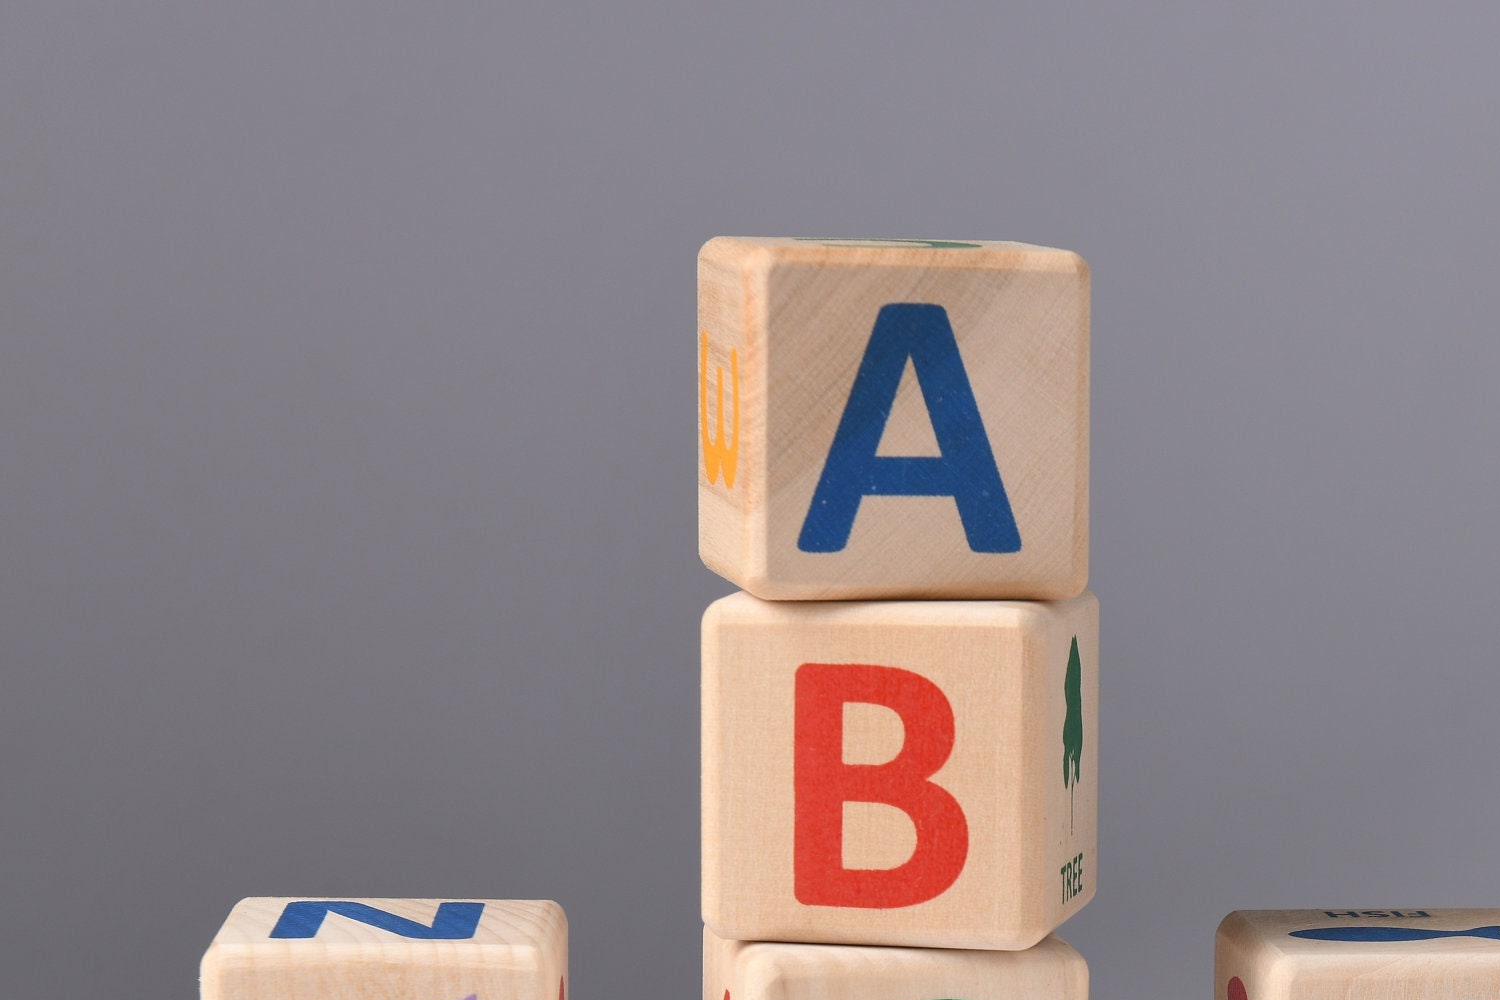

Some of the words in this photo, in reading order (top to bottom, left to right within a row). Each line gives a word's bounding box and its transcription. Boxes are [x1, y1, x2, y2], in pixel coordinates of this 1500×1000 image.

[797, 303, 1022, 554] A
[794, 662, 969, 909] B
[1061, 852, 1083, 905] TREE
[1323, 910, 1432, 918] FISH
